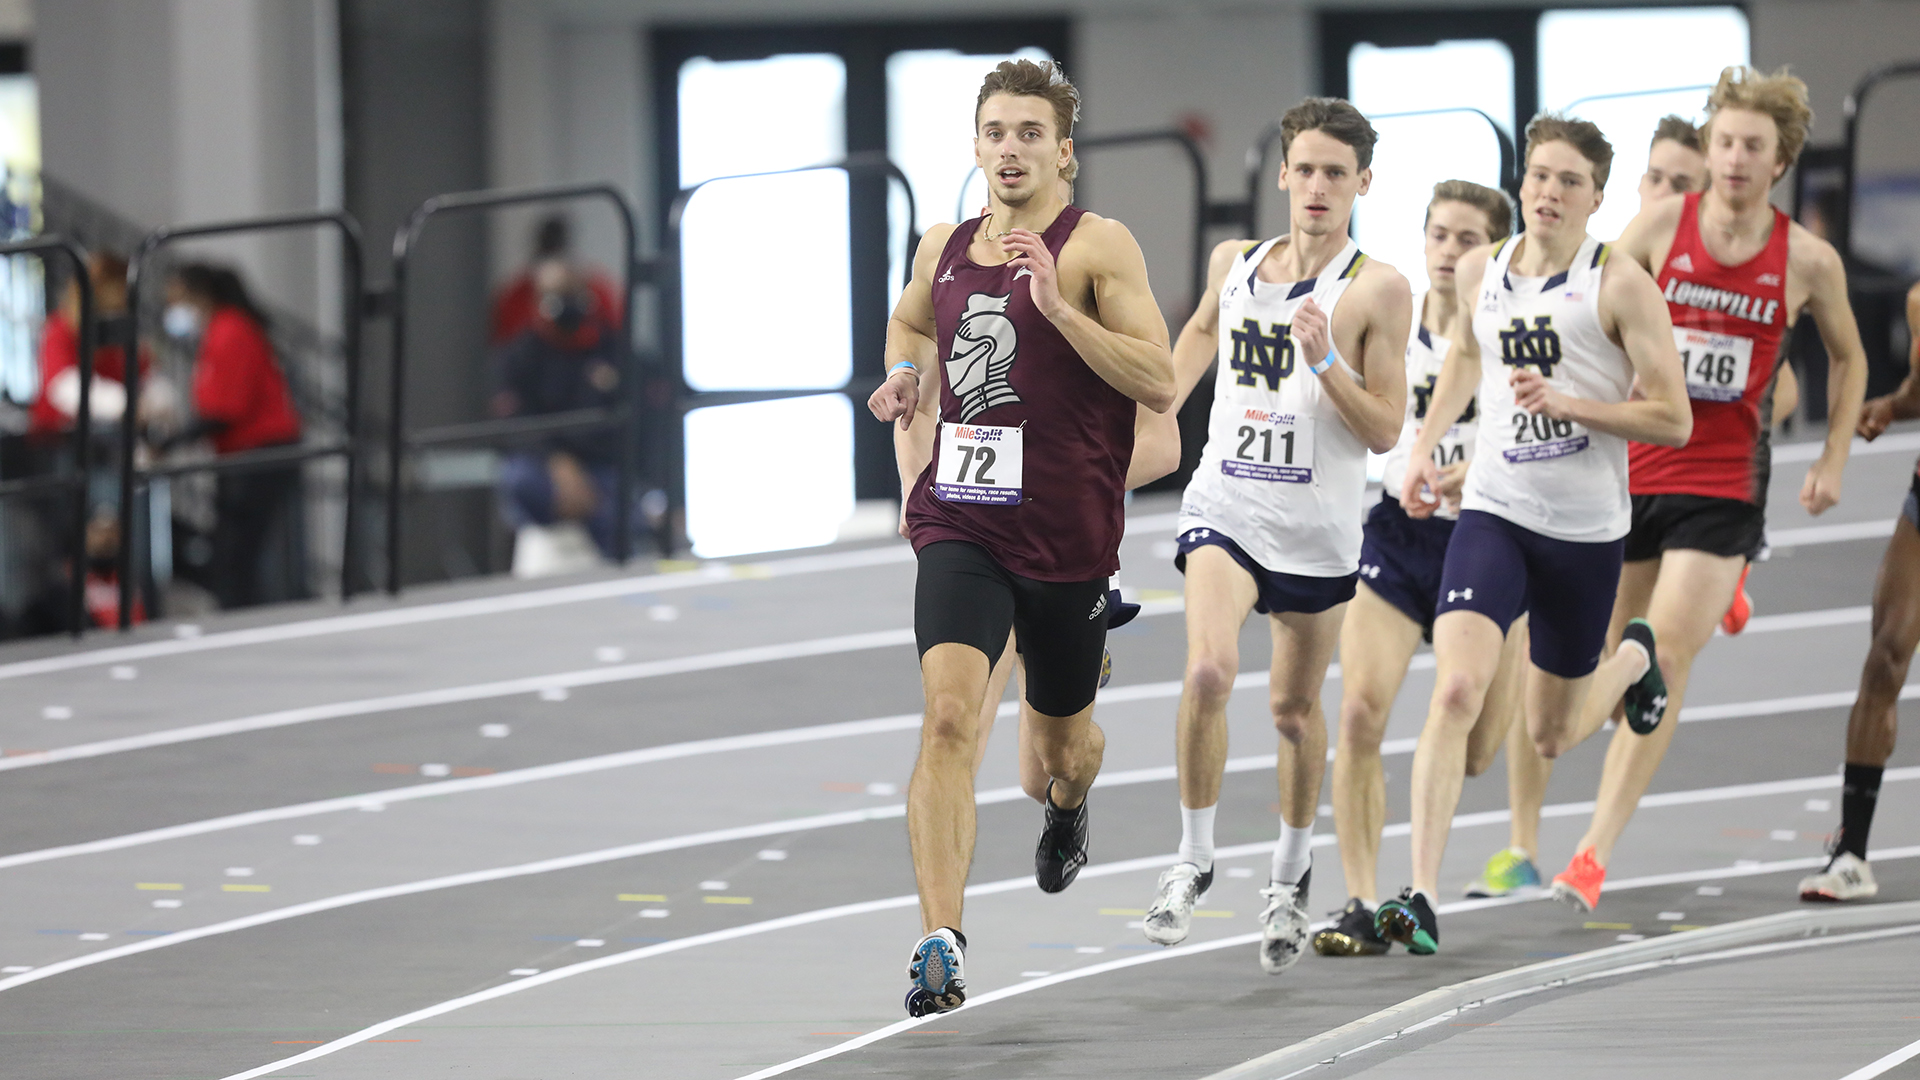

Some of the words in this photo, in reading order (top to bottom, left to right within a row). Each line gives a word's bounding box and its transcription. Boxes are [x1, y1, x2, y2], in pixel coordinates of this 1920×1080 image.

[1680, 349, 1736, 385] 146
[955, 426, 1003, 443] MileSplit
[1244, 409, 1296, 426] MileSplit
[1236, 425, 1294, 465] 211
[956, 445, 997, 485] 72
